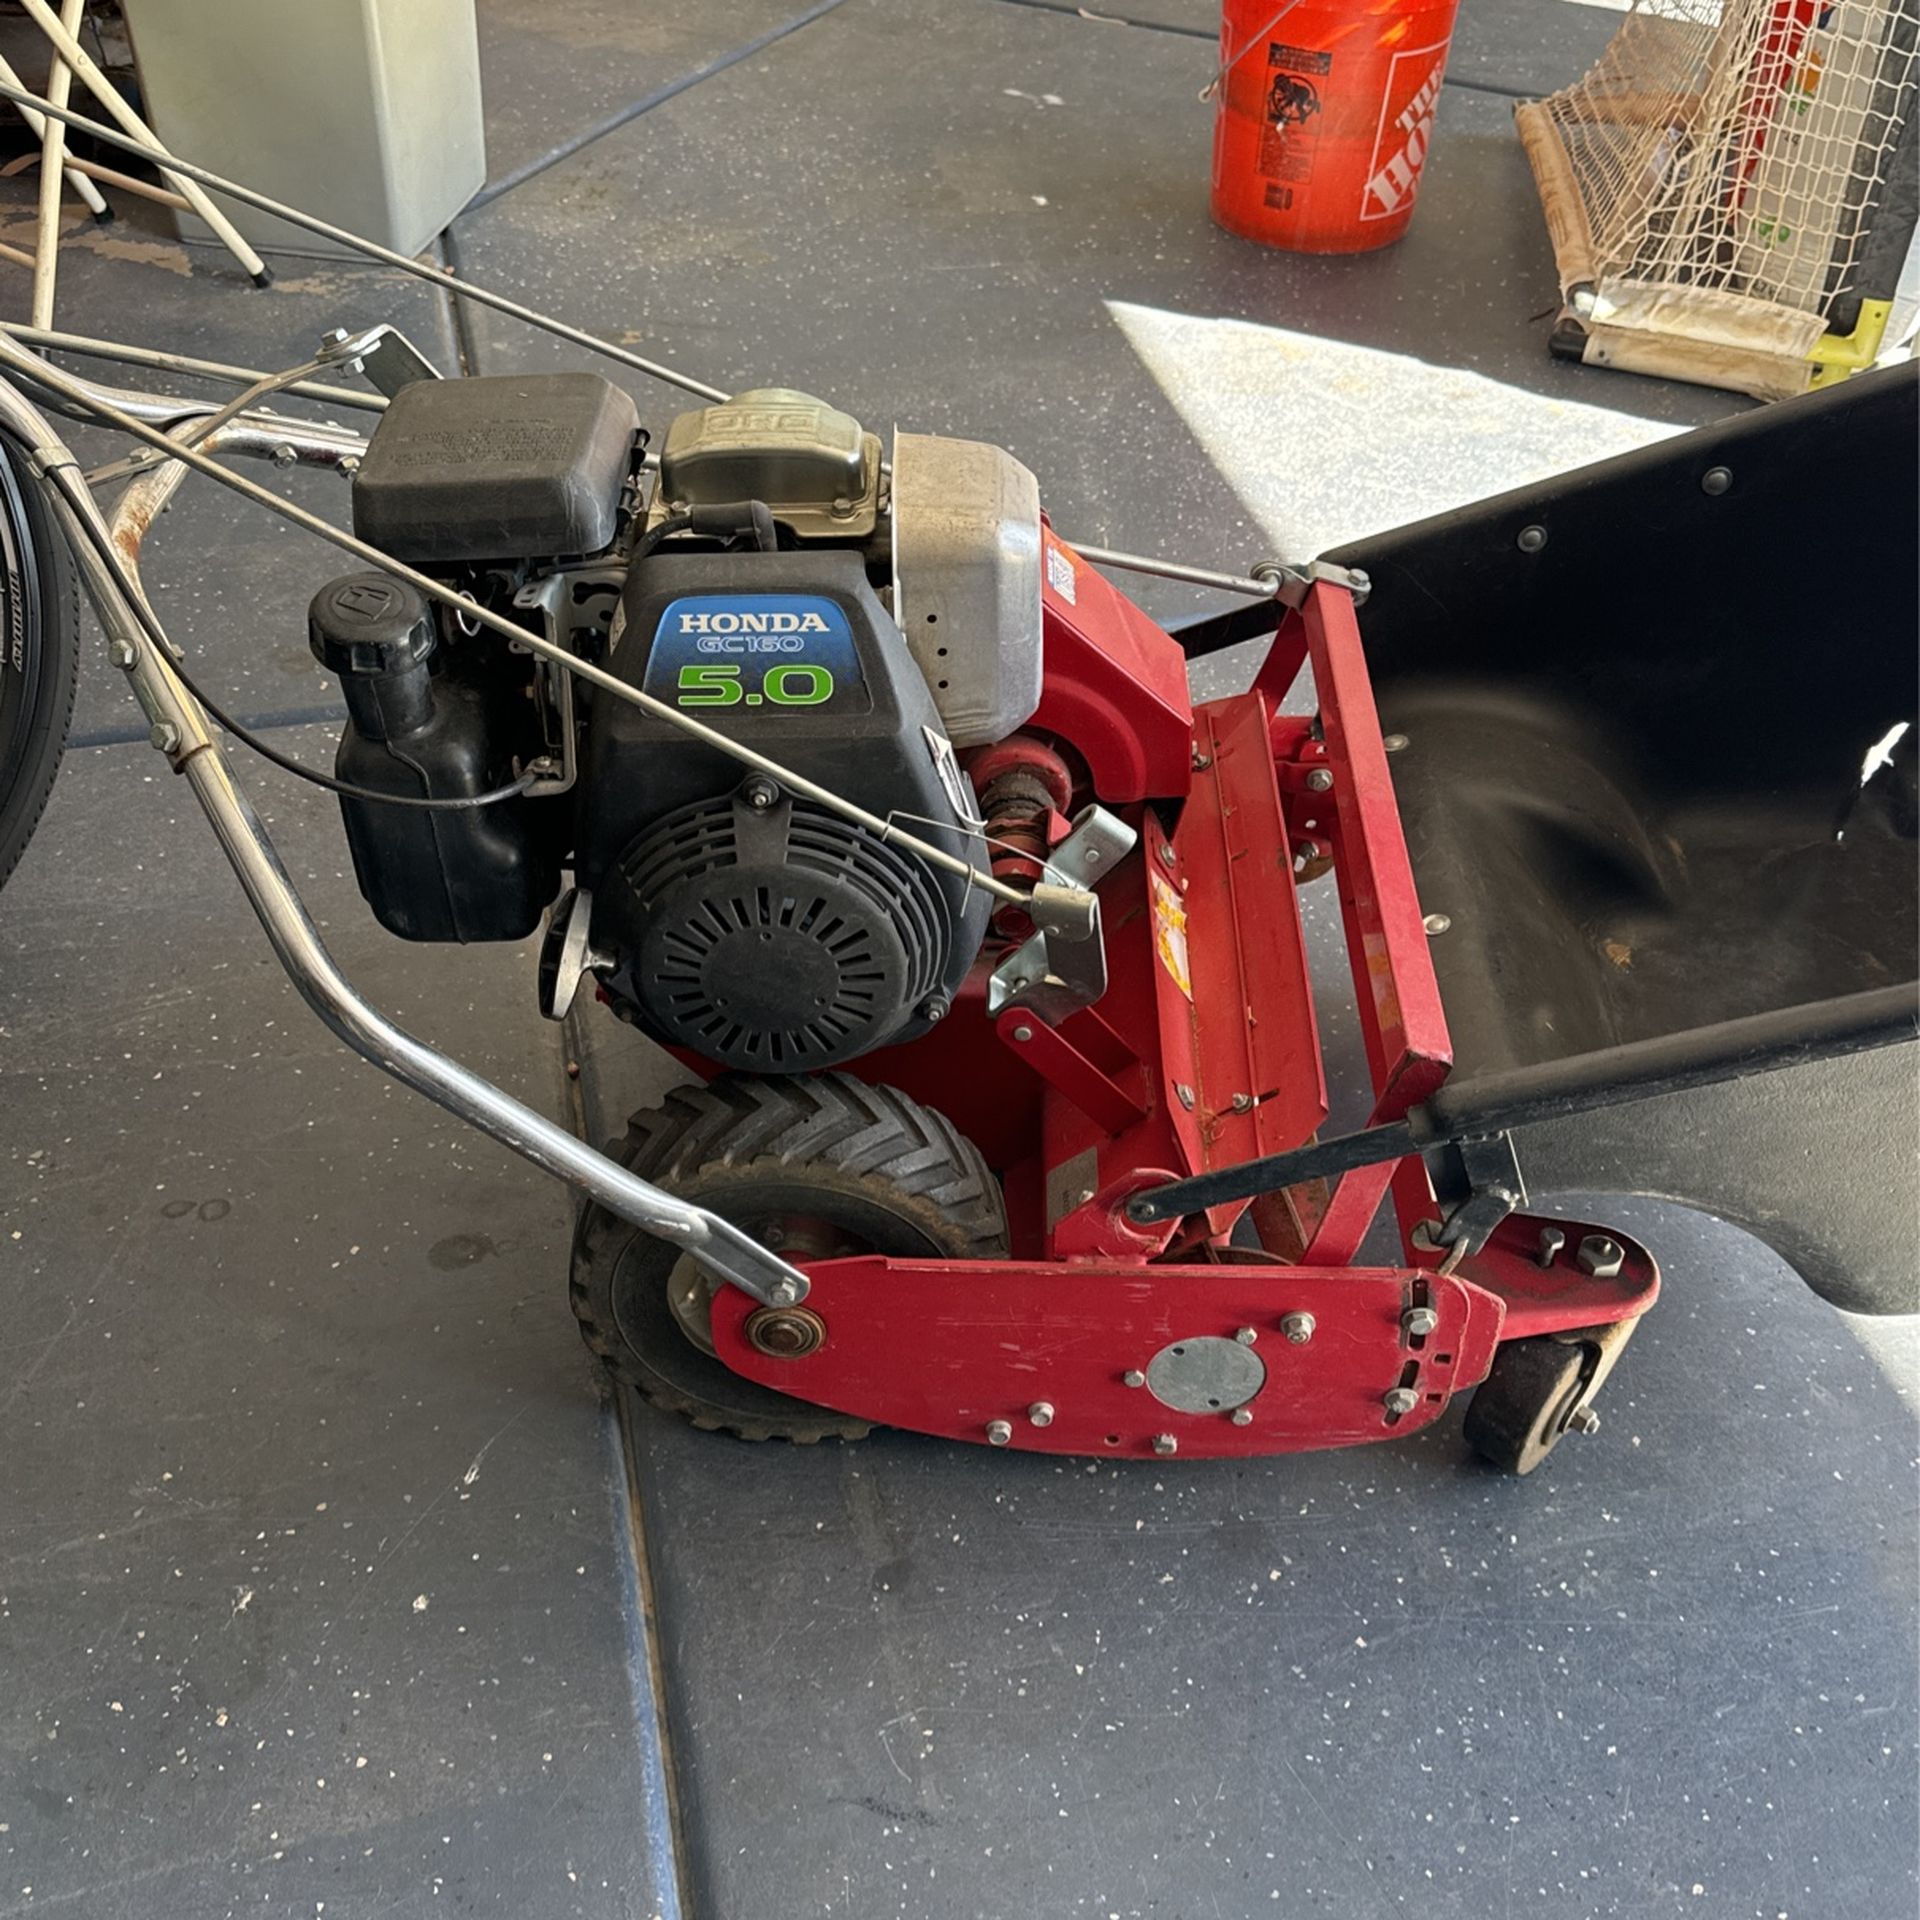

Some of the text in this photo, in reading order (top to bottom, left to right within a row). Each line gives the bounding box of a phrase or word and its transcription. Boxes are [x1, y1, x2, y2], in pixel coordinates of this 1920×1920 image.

[679, 612, 830, 633] HONDA
[697, 636, 804, 653] GC160
[678, 665, 833, 705] 5.0
